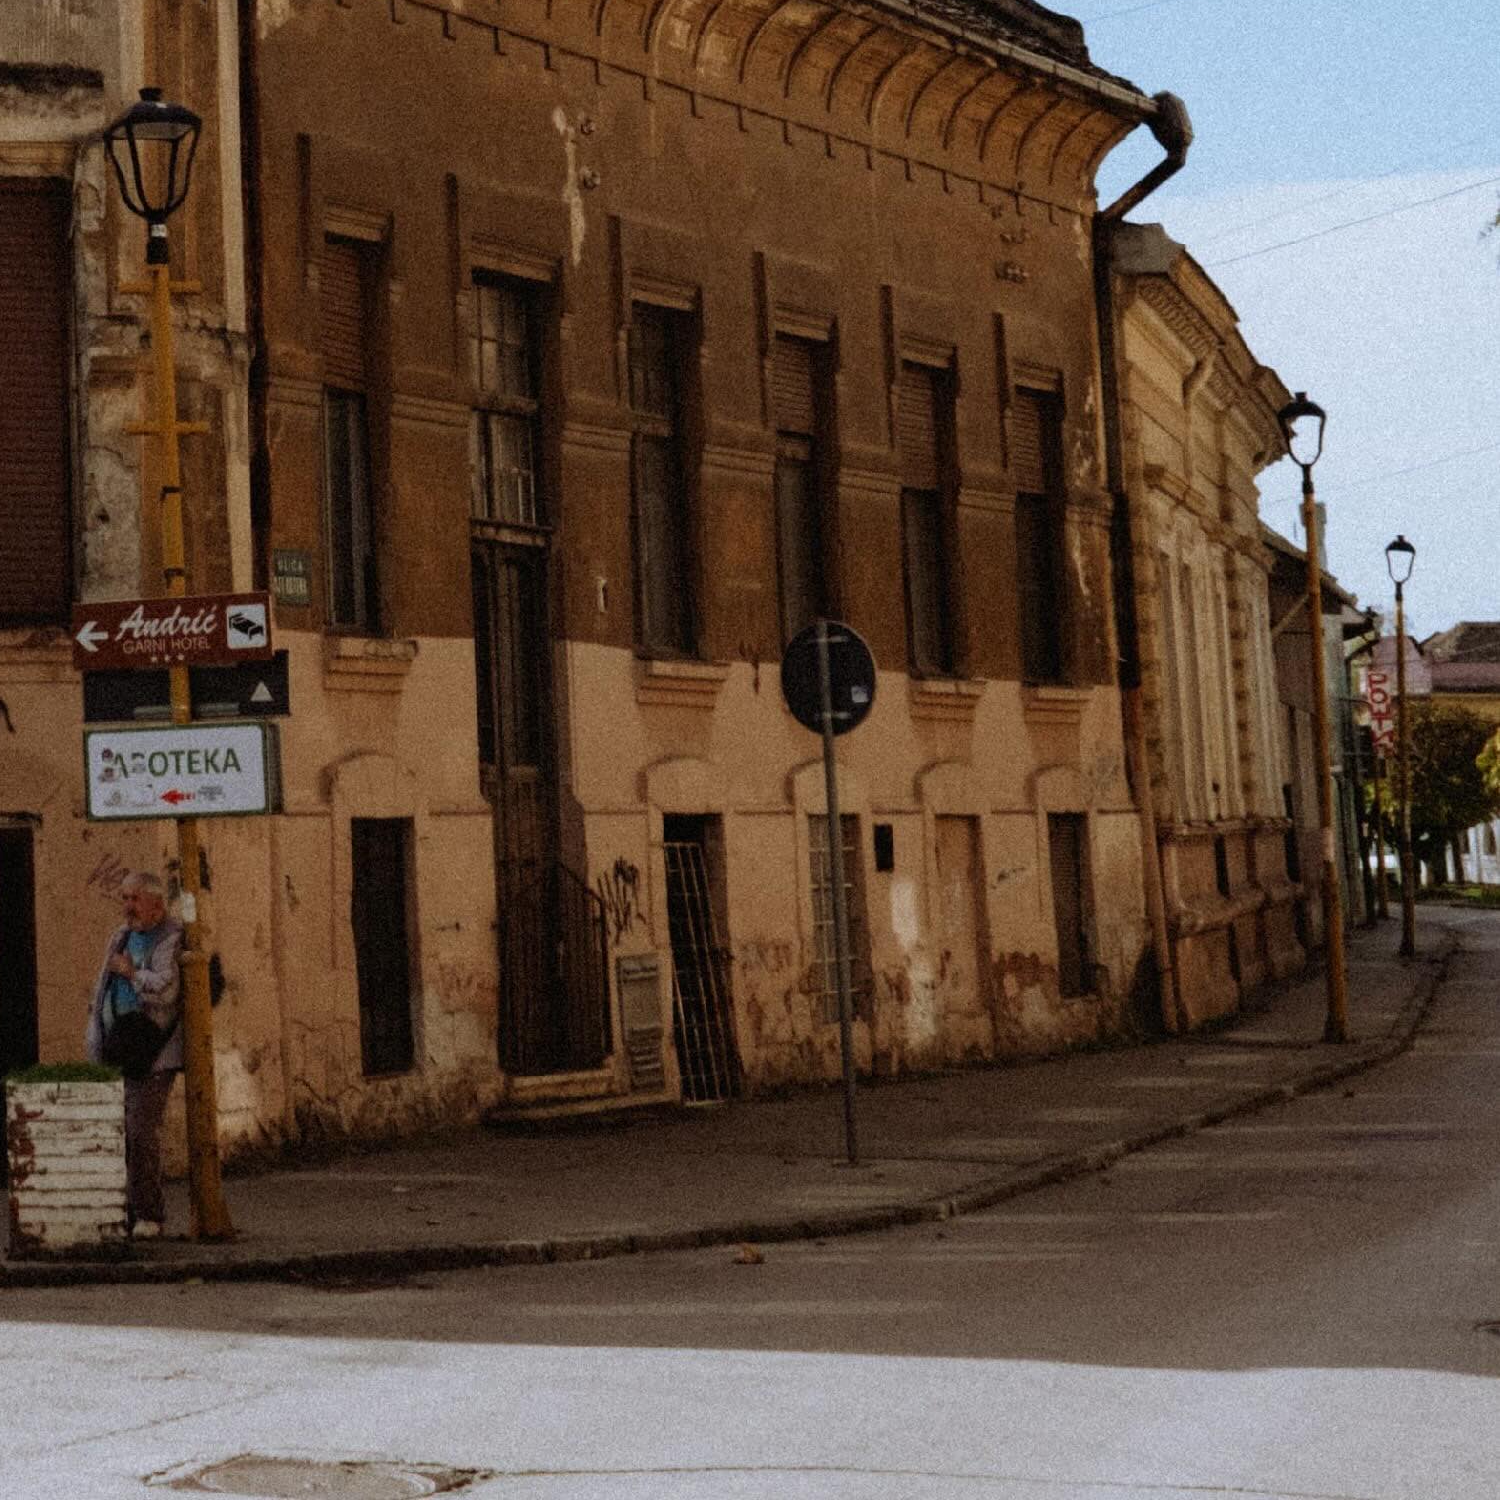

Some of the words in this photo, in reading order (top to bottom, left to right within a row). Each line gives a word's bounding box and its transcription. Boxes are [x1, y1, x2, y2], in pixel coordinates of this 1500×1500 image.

[113, 603, 219, 642] Andrić
[121, 638, 168, 655] GARNI
[169, 634, 211, 651] HOTEL
